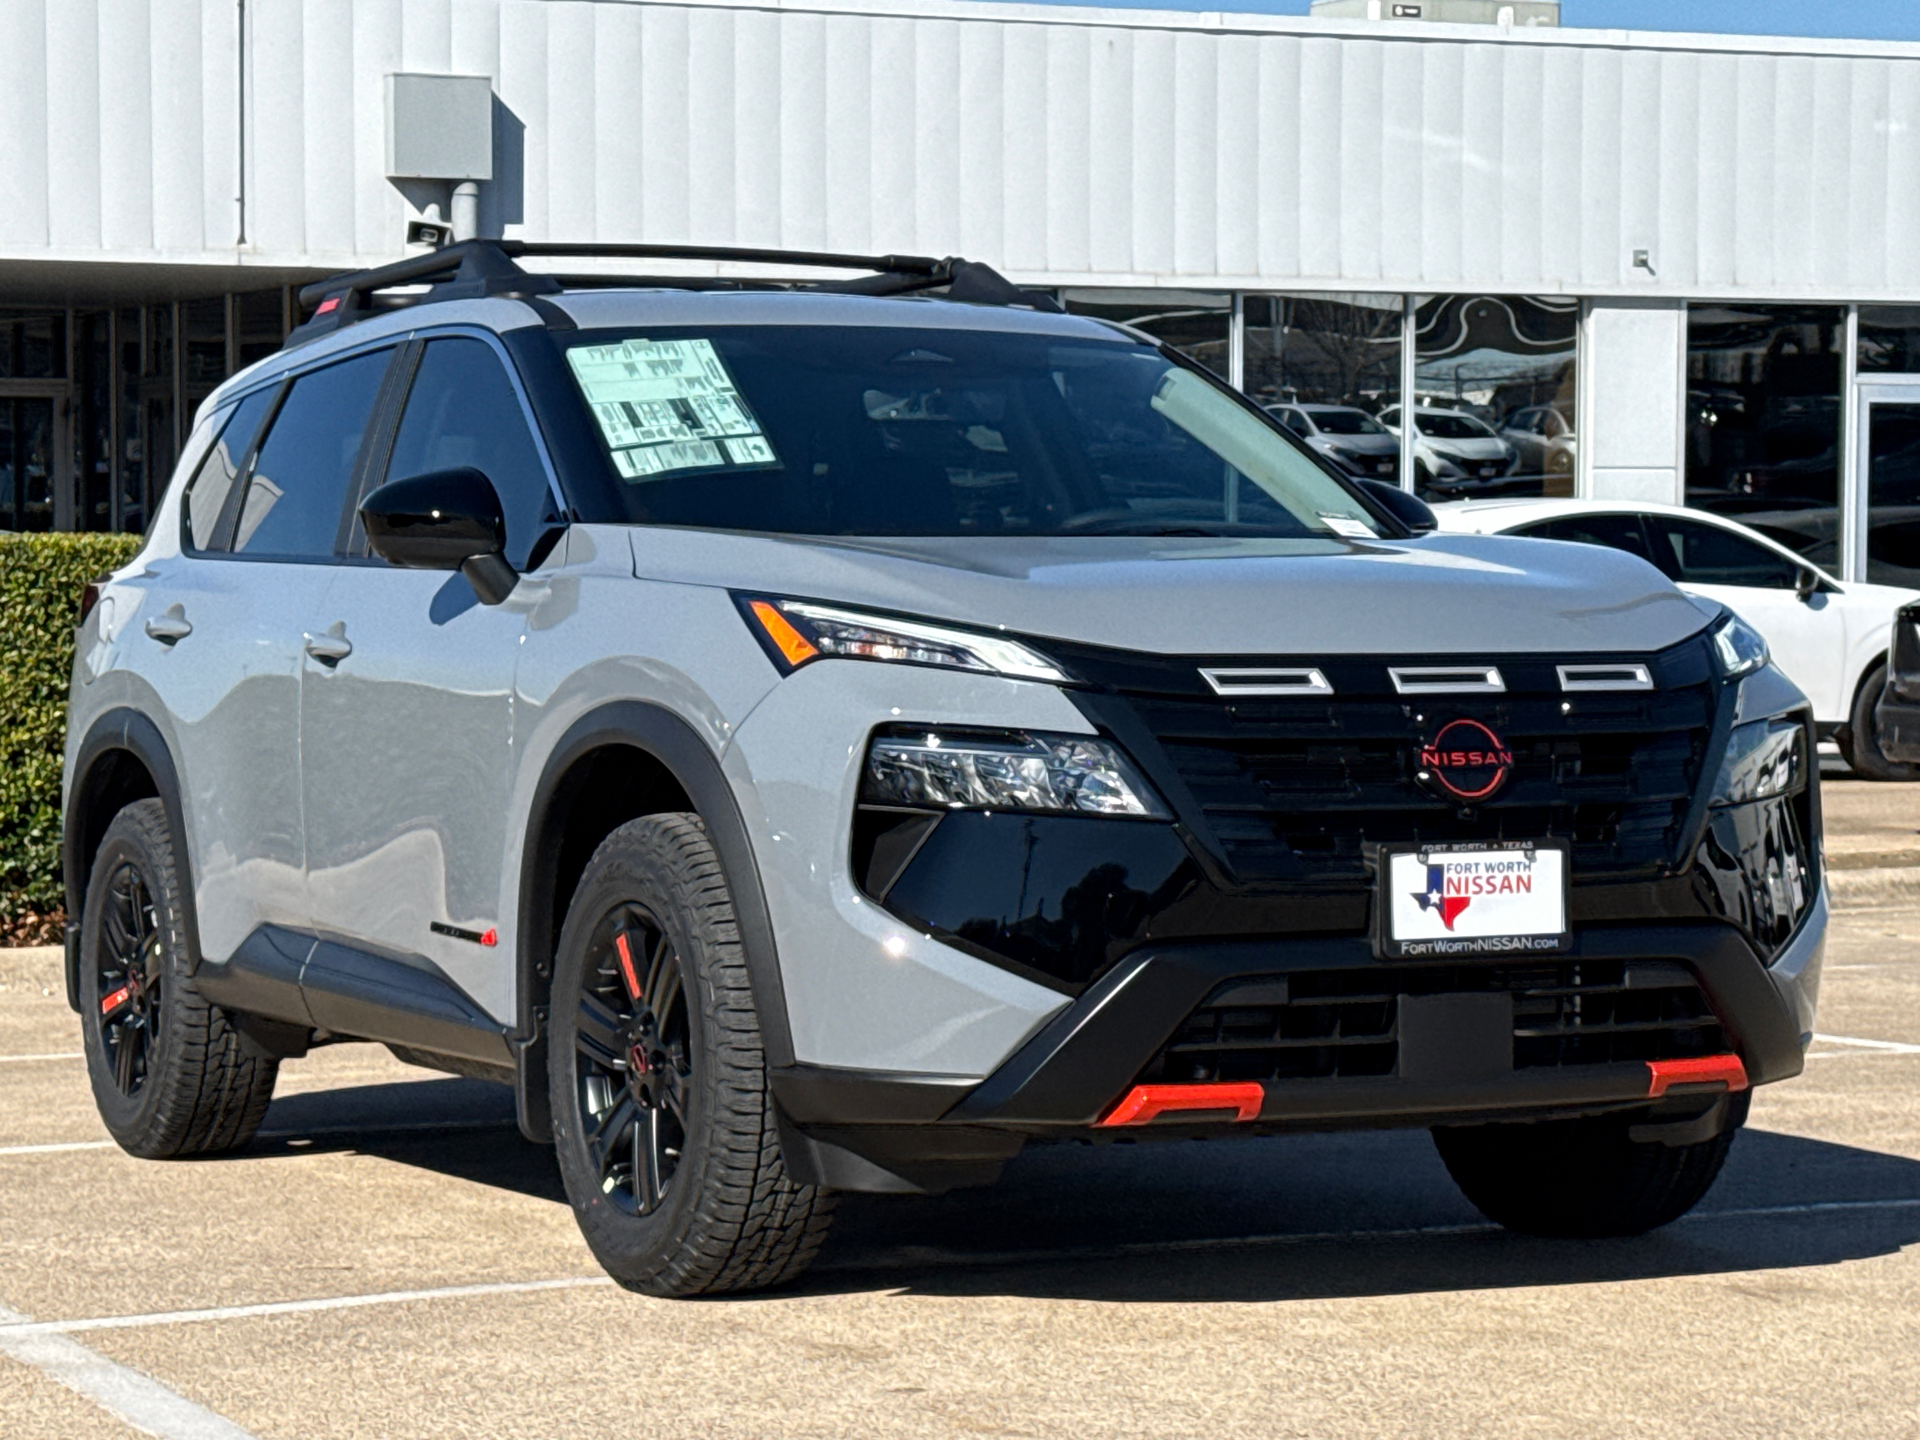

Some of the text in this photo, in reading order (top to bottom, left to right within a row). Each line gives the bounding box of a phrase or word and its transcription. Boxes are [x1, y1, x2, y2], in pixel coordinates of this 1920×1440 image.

[1421, 751, 1512, 767] NISSAN
[1421, 841, 1534, 852] FORT WORTH TEXAS
[1446, 861, 1532, 874] FORT WORTH
[1446, 874, 1532, 895] NISSAN
